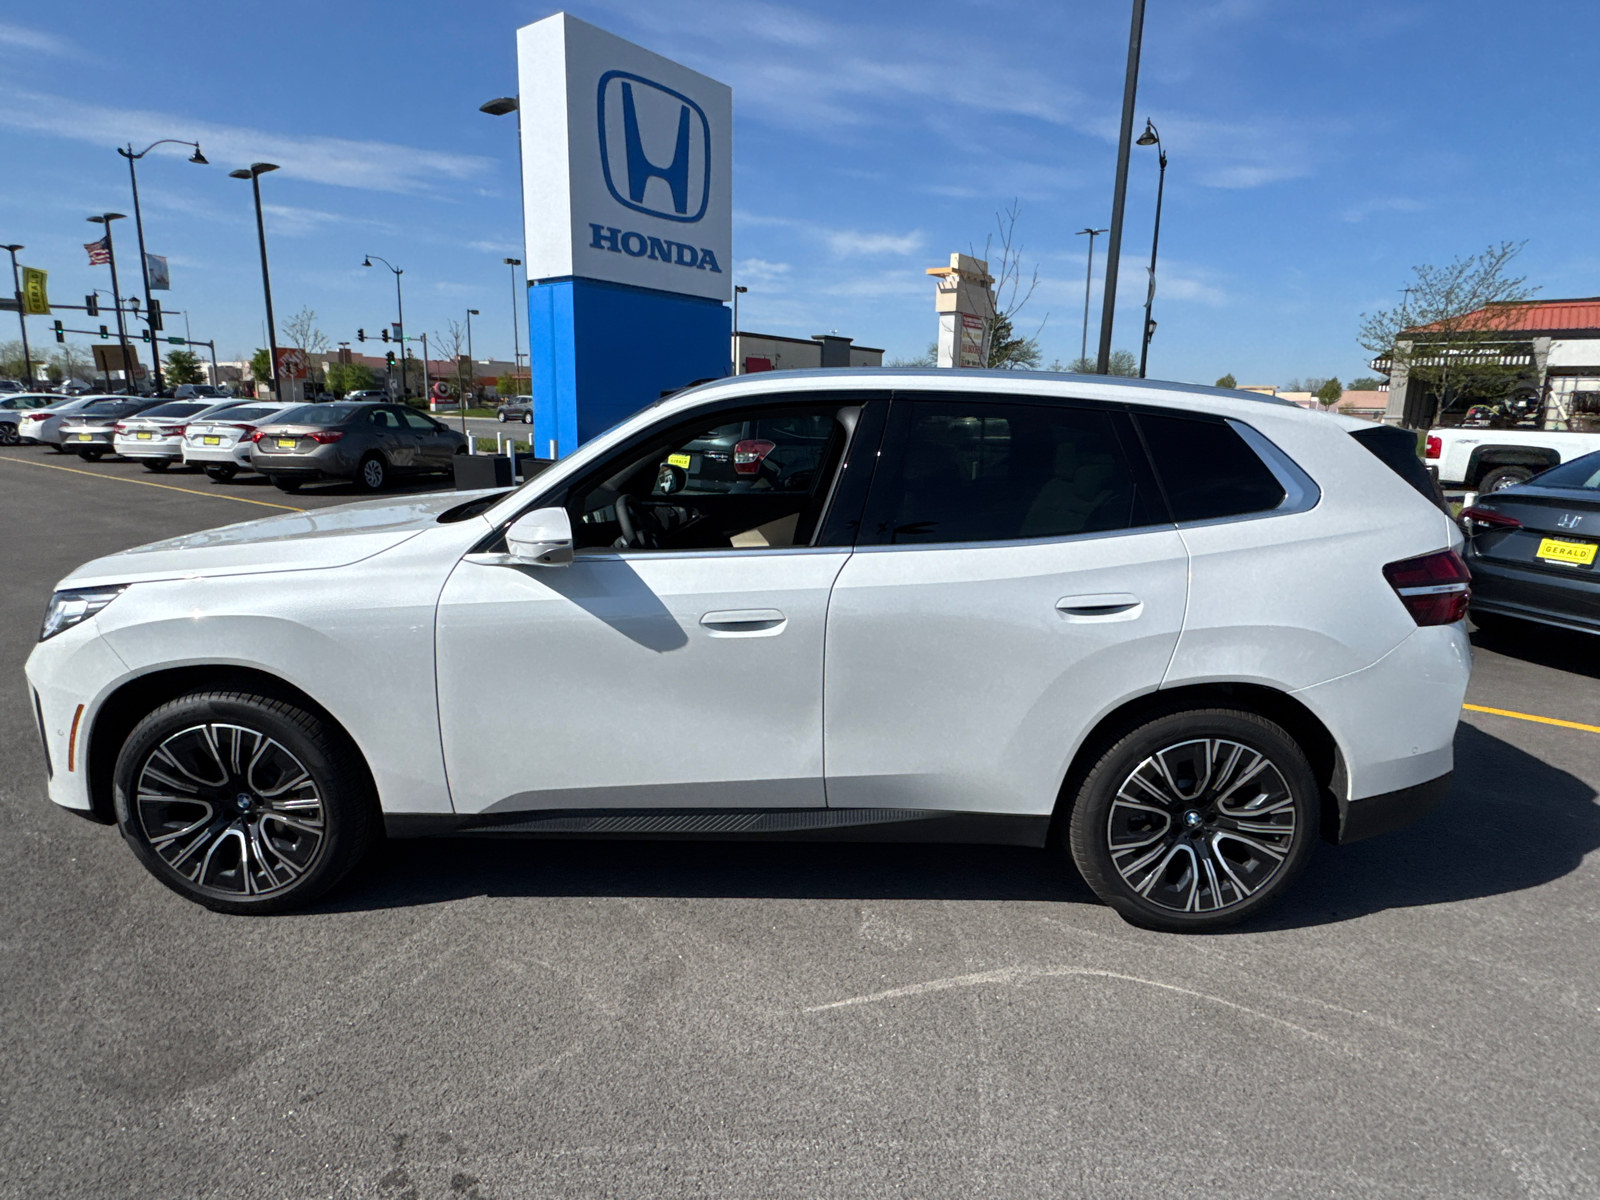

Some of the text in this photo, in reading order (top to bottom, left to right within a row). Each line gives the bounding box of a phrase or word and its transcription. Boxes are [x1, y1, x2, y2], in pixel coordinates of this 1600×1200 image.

[589, 222, 722, 273] HONDA
[31, 272, 41, 310] GERALD
[1545, 545, 1587, 558] GERALD
